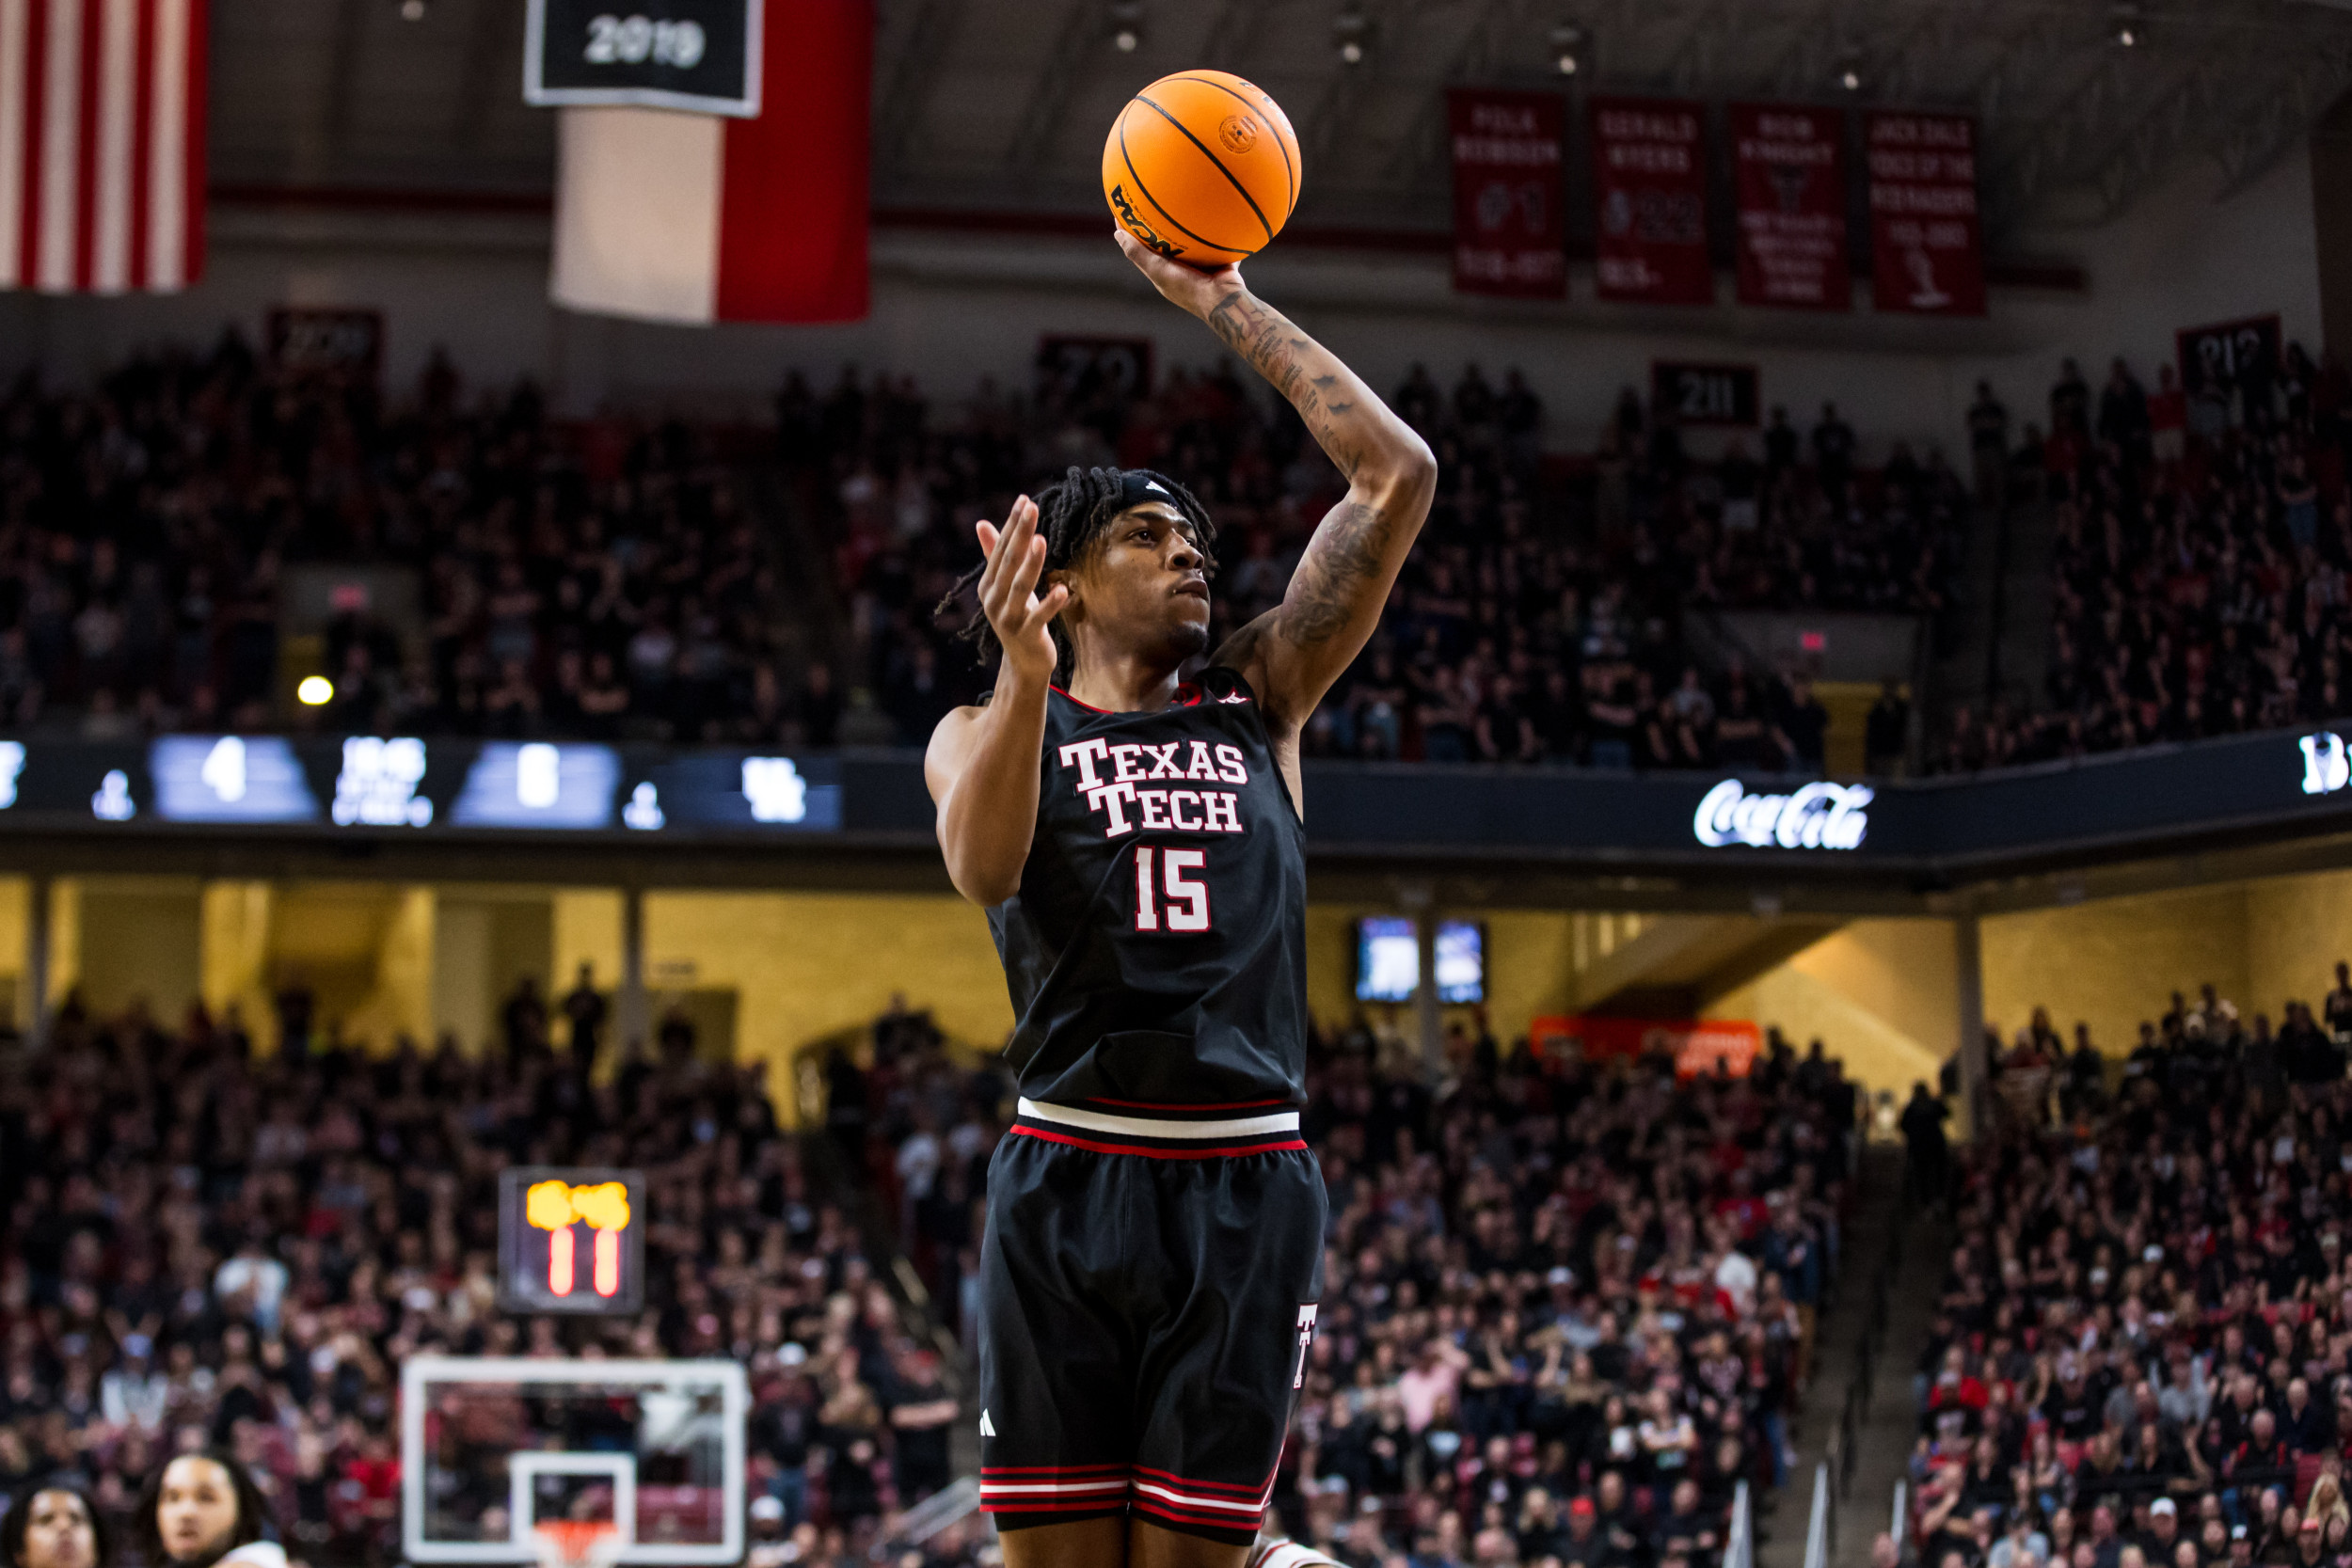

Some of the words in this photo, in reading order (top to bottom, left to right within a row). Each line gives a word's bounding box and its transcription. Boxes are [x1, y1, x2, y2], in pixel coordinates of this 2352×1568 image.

[582, 13, 706, 71] 2019
[1109, 183, 1185, 259] NCAA
[1058, 737, 1248, 792] TEXAS
[1088, 782, 1244, 839] TECH
[1134, 846, 1212, 933] 15
